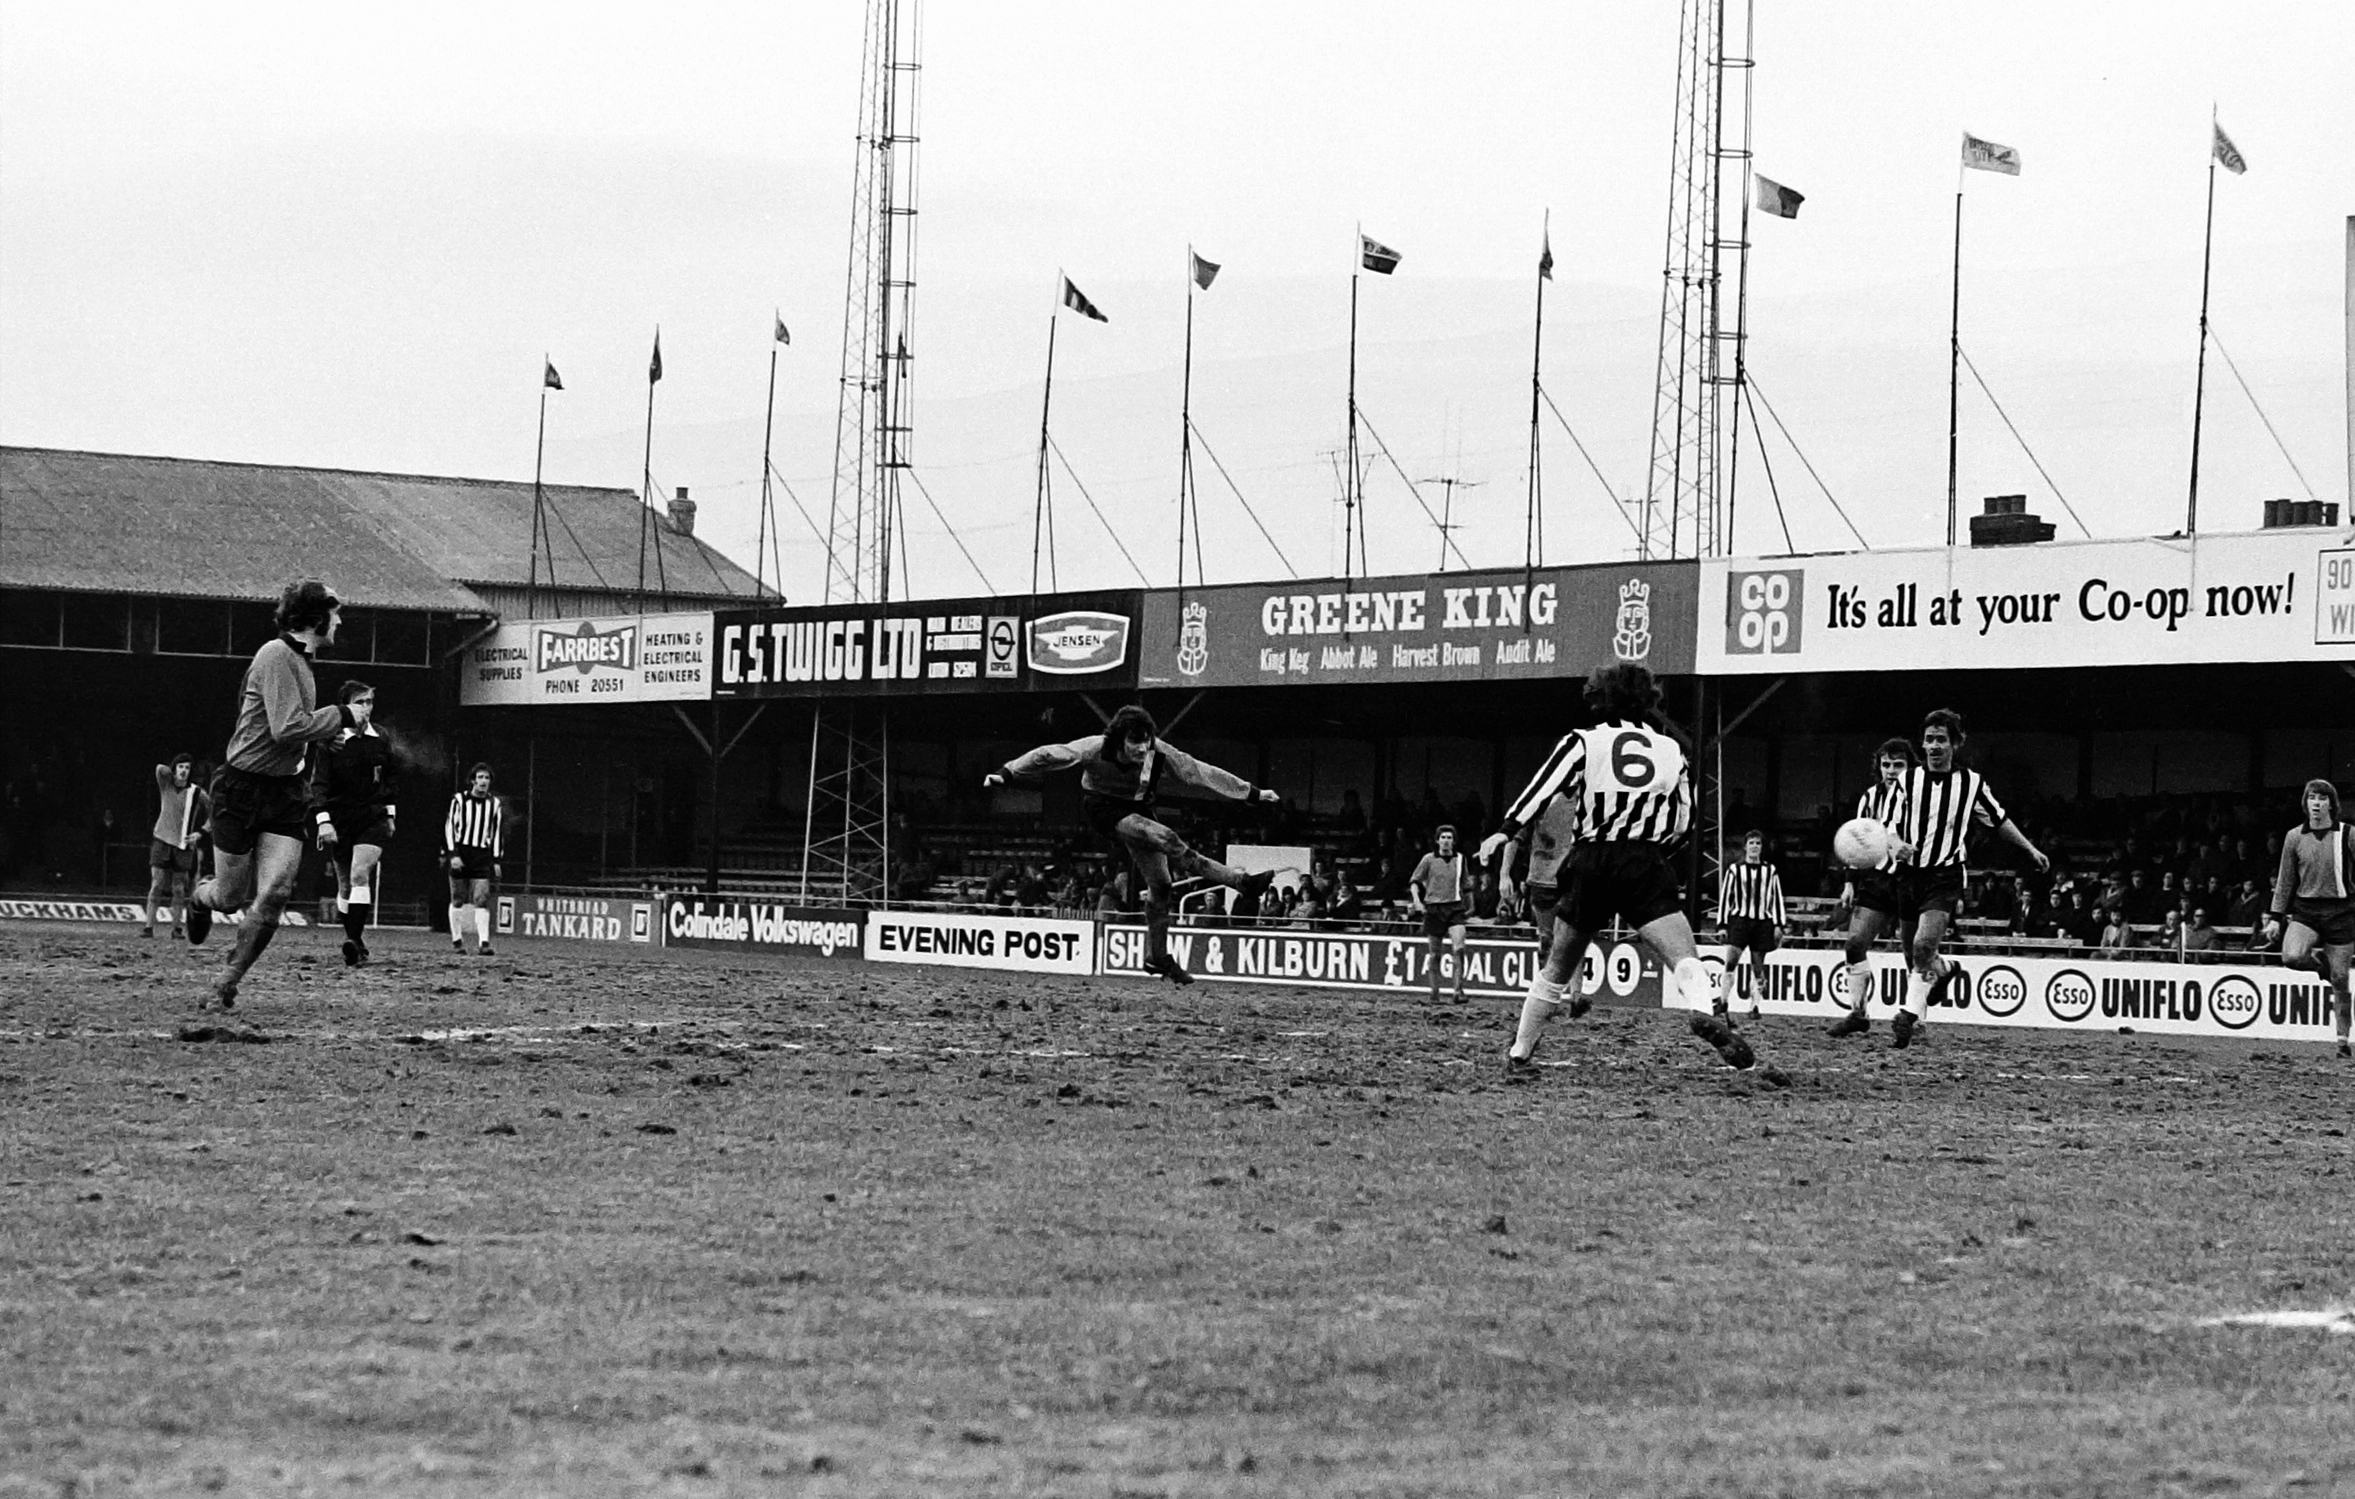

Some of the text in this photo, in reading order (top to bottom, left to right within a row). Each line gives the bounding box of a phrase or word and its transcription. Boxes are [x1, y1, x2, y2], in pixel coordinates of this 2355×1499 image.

[1262, 583, 1557, 635] GREENE KING
[1827, 572, 2294, 635] It's all at your Co-op now!
[475, 647, 528, 662] ELECTRICAL
[539, 628, 634, 670] FARRBEST
[646, 631, 703, 646] HEATING &
[872, 618, 922, 679] LTD
[1053, 636, 1101, 647] JENSEN
[1260, 638, 1555, 674] King Keg Abbot Ale Harvest Brown Audit Ale
[479, 667, 523, 682] SUPPLIES
[643, 650, 702, 665] ELECTRICAL
[546, 678, 624, 693] PHONE 20551
[644, 669, 701, 683] ENGINEERS
[1612, 732, 1655, 788] 6
[522, 912, 621, 940] TANKARD
[670, 901, 858, 956] Colindale Volkswagen
[880, 925, 1079, 961] EVENING POST
[1109, 932, 1193, 971] SHW
[1205, 936, 1224, 973] &
[1237, 937, 1370, 981] KILBURN
[1384, 940, 1416, 986] £1
[1440, 952, 1496, 984] GAL
[1617, 958, 1630, 983] 9
[2102, 978, 2202, 1021] UNIFLO
